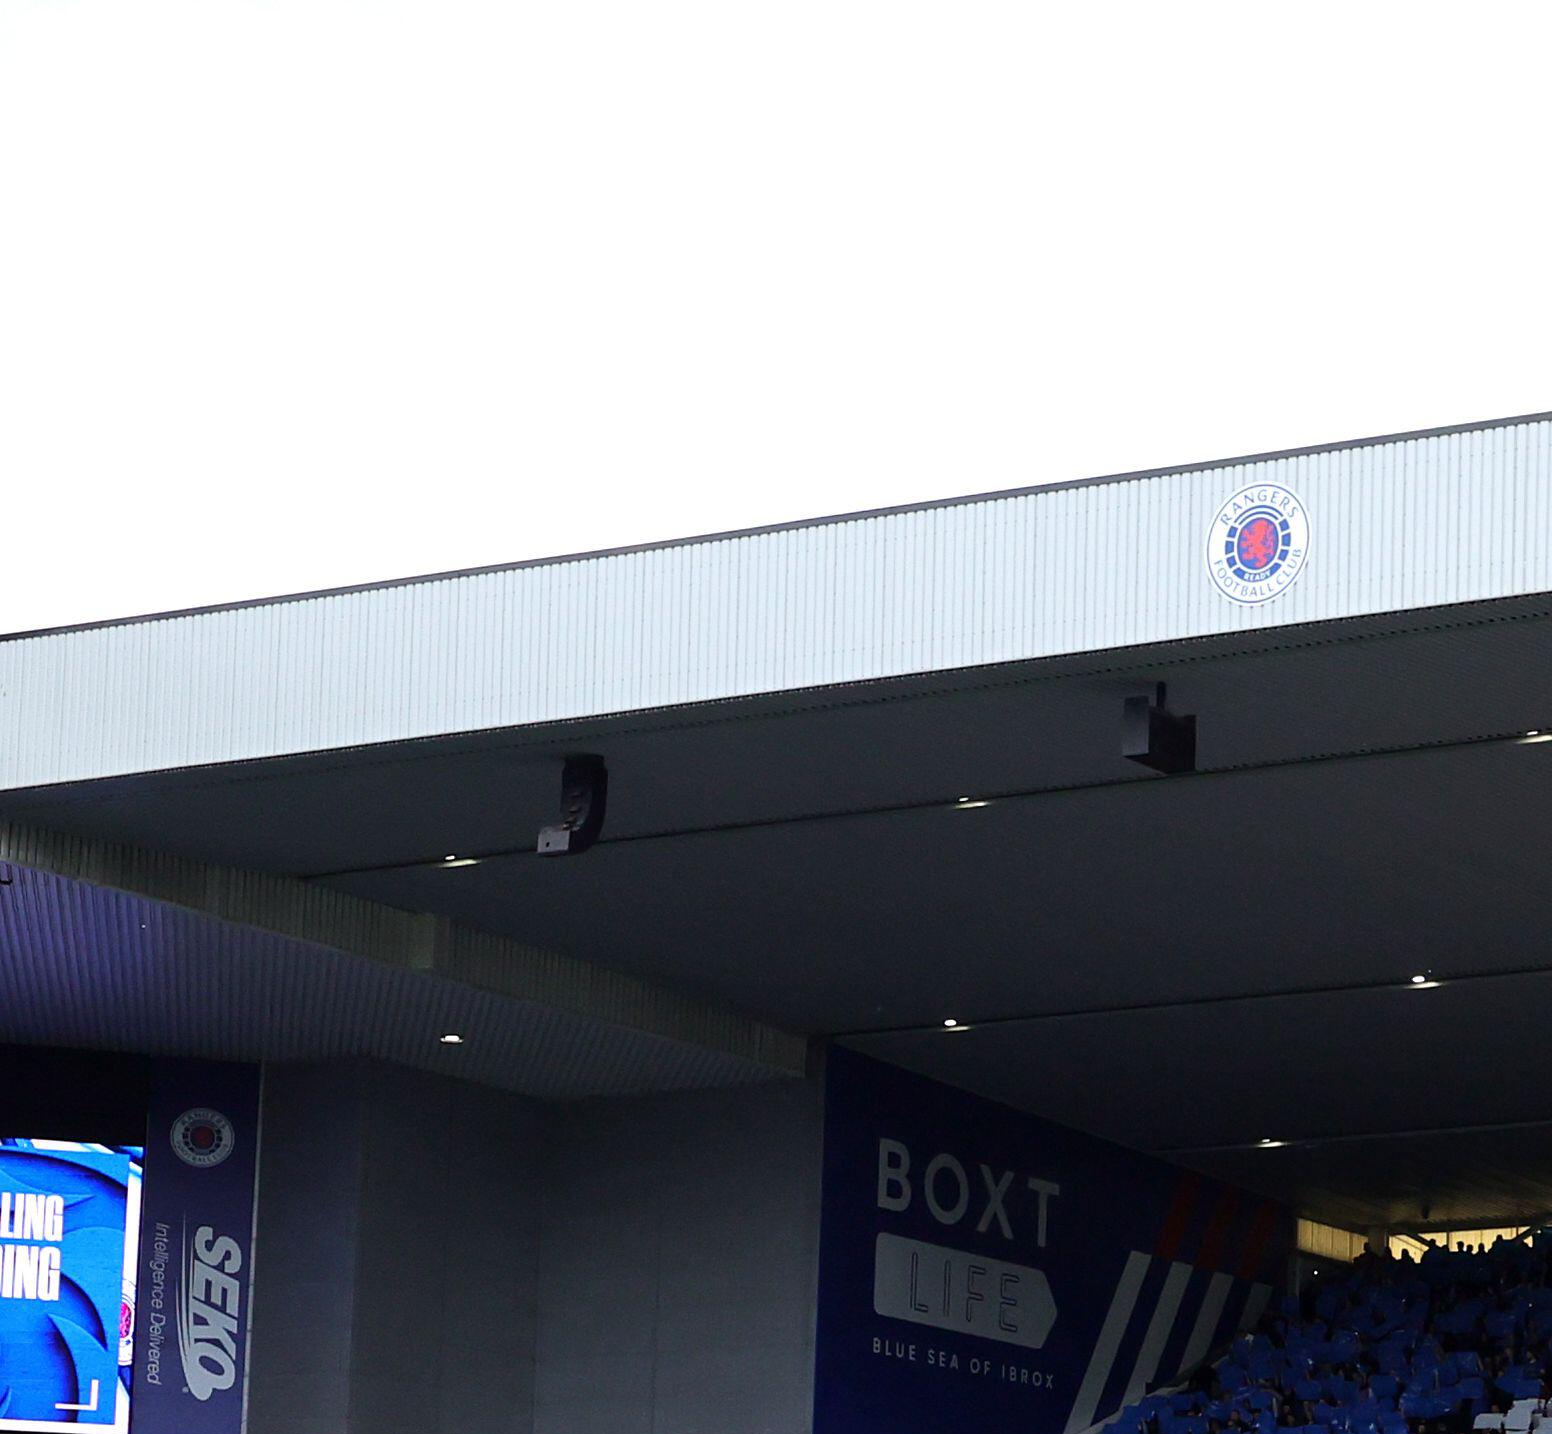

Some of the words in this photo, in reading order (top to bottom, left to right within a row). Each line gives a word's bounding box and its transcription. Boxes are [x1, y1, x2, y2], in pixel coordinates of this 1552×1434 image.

[1220, 489, 1299, 526] RANGERS
[1214, 559, 1274, 598] FOOTBALL
[1275, 548, 1302, 586] CLUB
[877, 1137, 1060, 1248] BOXT
[150, 1222, 170, 1309] Intelligence
[910, 1251, 1021, 1334] LIFE
[147, 1312, 166, 1386] Delivered
[192, 1226, 242, 1401] SEKO
[873, 1336, 916, 1361] BLUE
[928, 1349, 959, 1371] SEA
[970, 1358, 992, 1377] OF
[1002, 1365, 1054, 1390] IBROX
